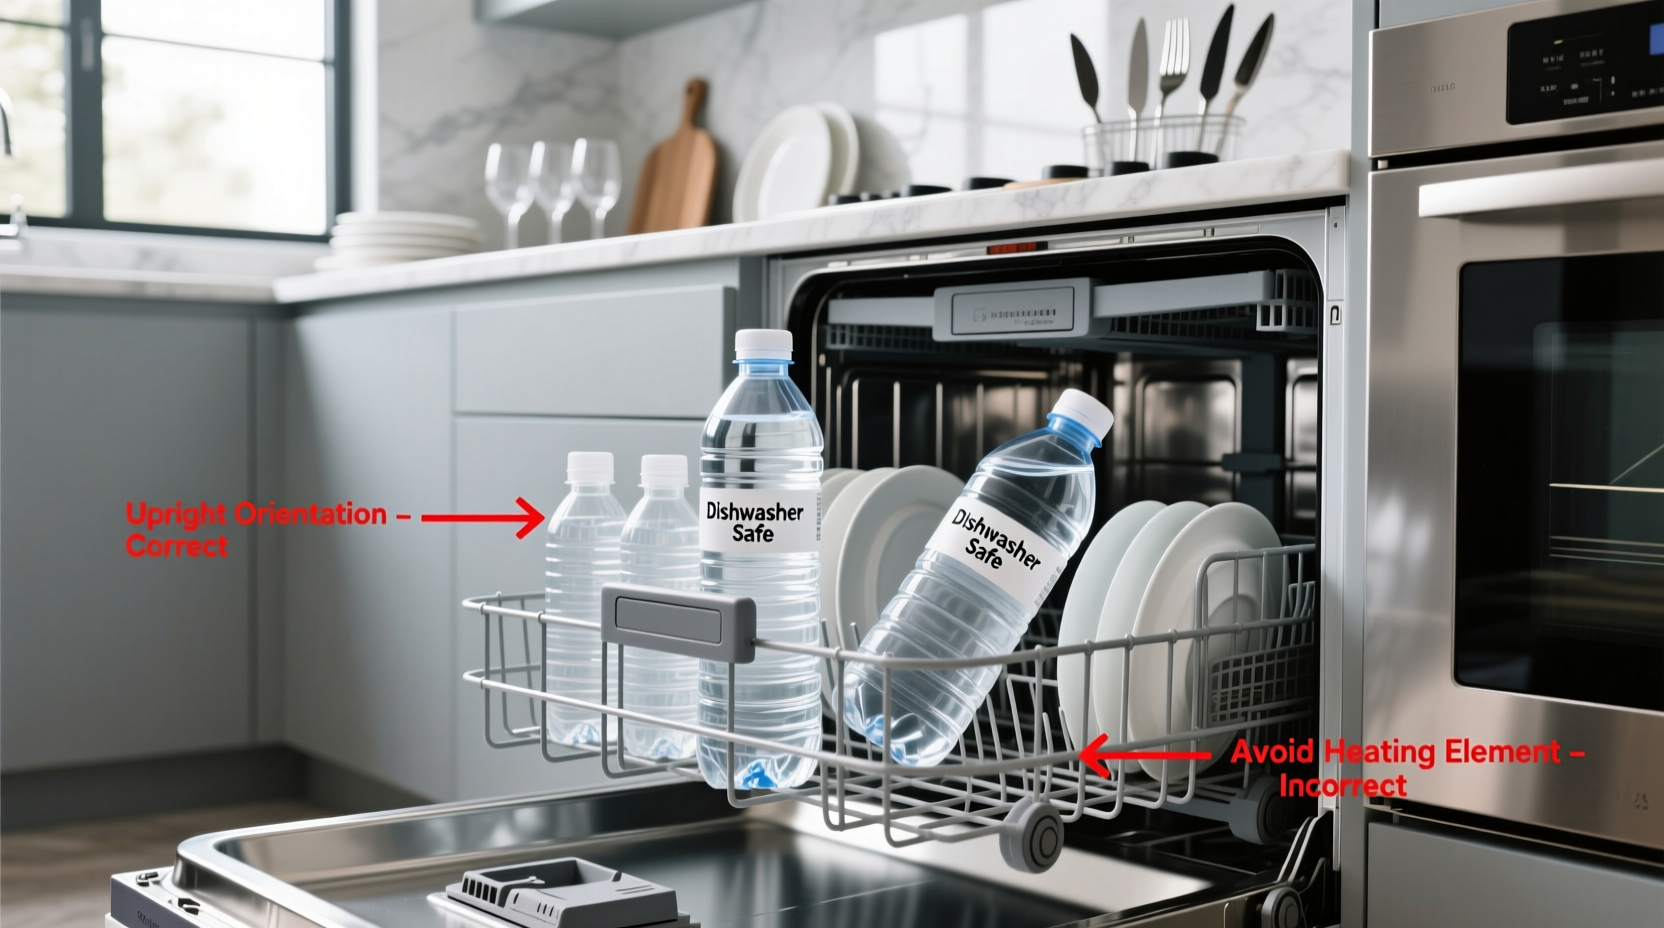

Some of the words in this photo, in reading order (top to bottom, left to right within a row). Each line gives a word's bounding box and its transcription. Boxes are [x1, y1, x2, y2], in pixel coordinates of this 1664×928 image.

[706, 501, 804, 521] Dishwasher
[732, 523, 775, 542] Safe
[952, 508, 1041, 571] Dishwasher
[965, 538, 1003, 569] Safe
